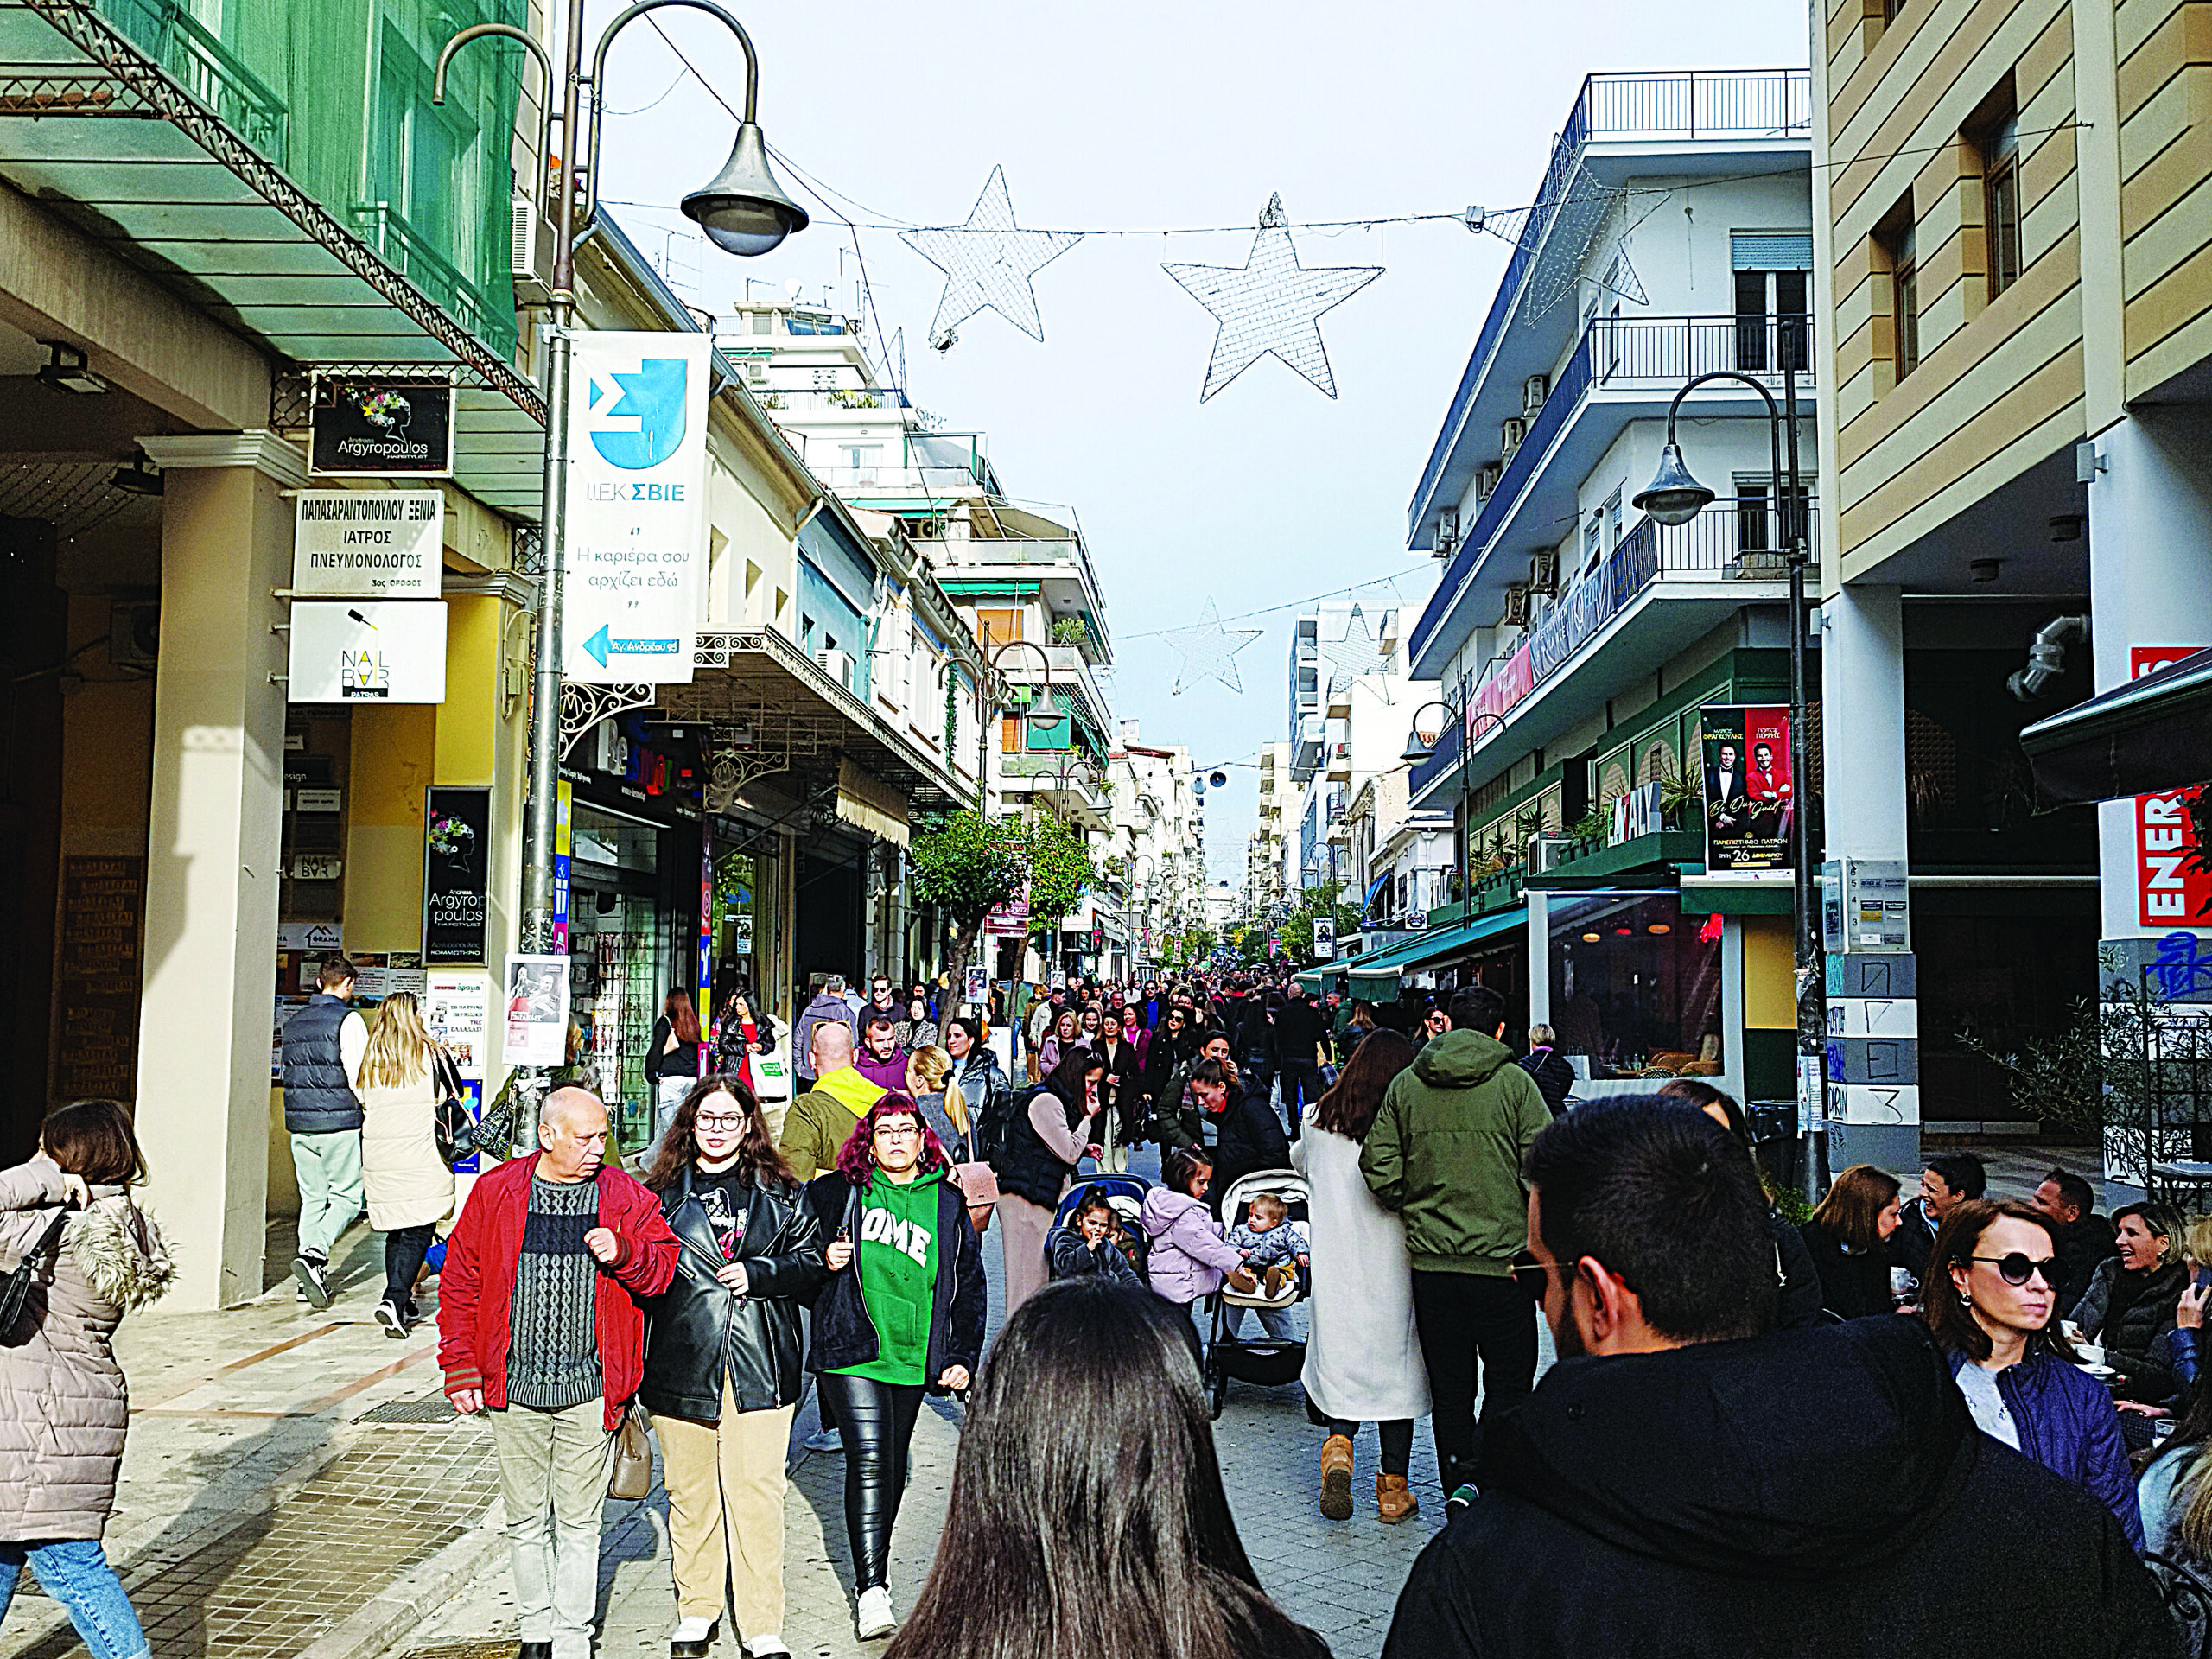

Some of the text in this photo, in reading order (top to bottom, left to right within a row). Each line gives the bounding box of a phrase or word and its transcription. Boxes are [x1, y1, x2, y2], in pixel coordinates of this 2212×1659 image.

[338, 440, 429, 456] Argyropoulos
[632, 483, 684, 502] ΣΒΙΕ
[302, 500, 435, 520] ΠΑΠΑΣΑΡΑΝΤΟΠΟΥΛΟΥ ΞΕΝΙΑ
[344, 531, 391, 544] ΙΑΤΡΟΣ
[310, 553, 422, 568] ΠΝΕΥΜΟΝΟΛΟΓΟΣ
[594, 547, 658, 566] καριέρα
[662, 553, 690, 563] σου
[372, 579, 386, 588] 3ος
[588, 570, 678, 590] αρχίζει εδώ
[284, 771, 307, 782] esign
[1732, 849, 1750, 861] 26
[2144, 791, 2187, 918] ENER
[861, 1205, 931, 1268] OME
